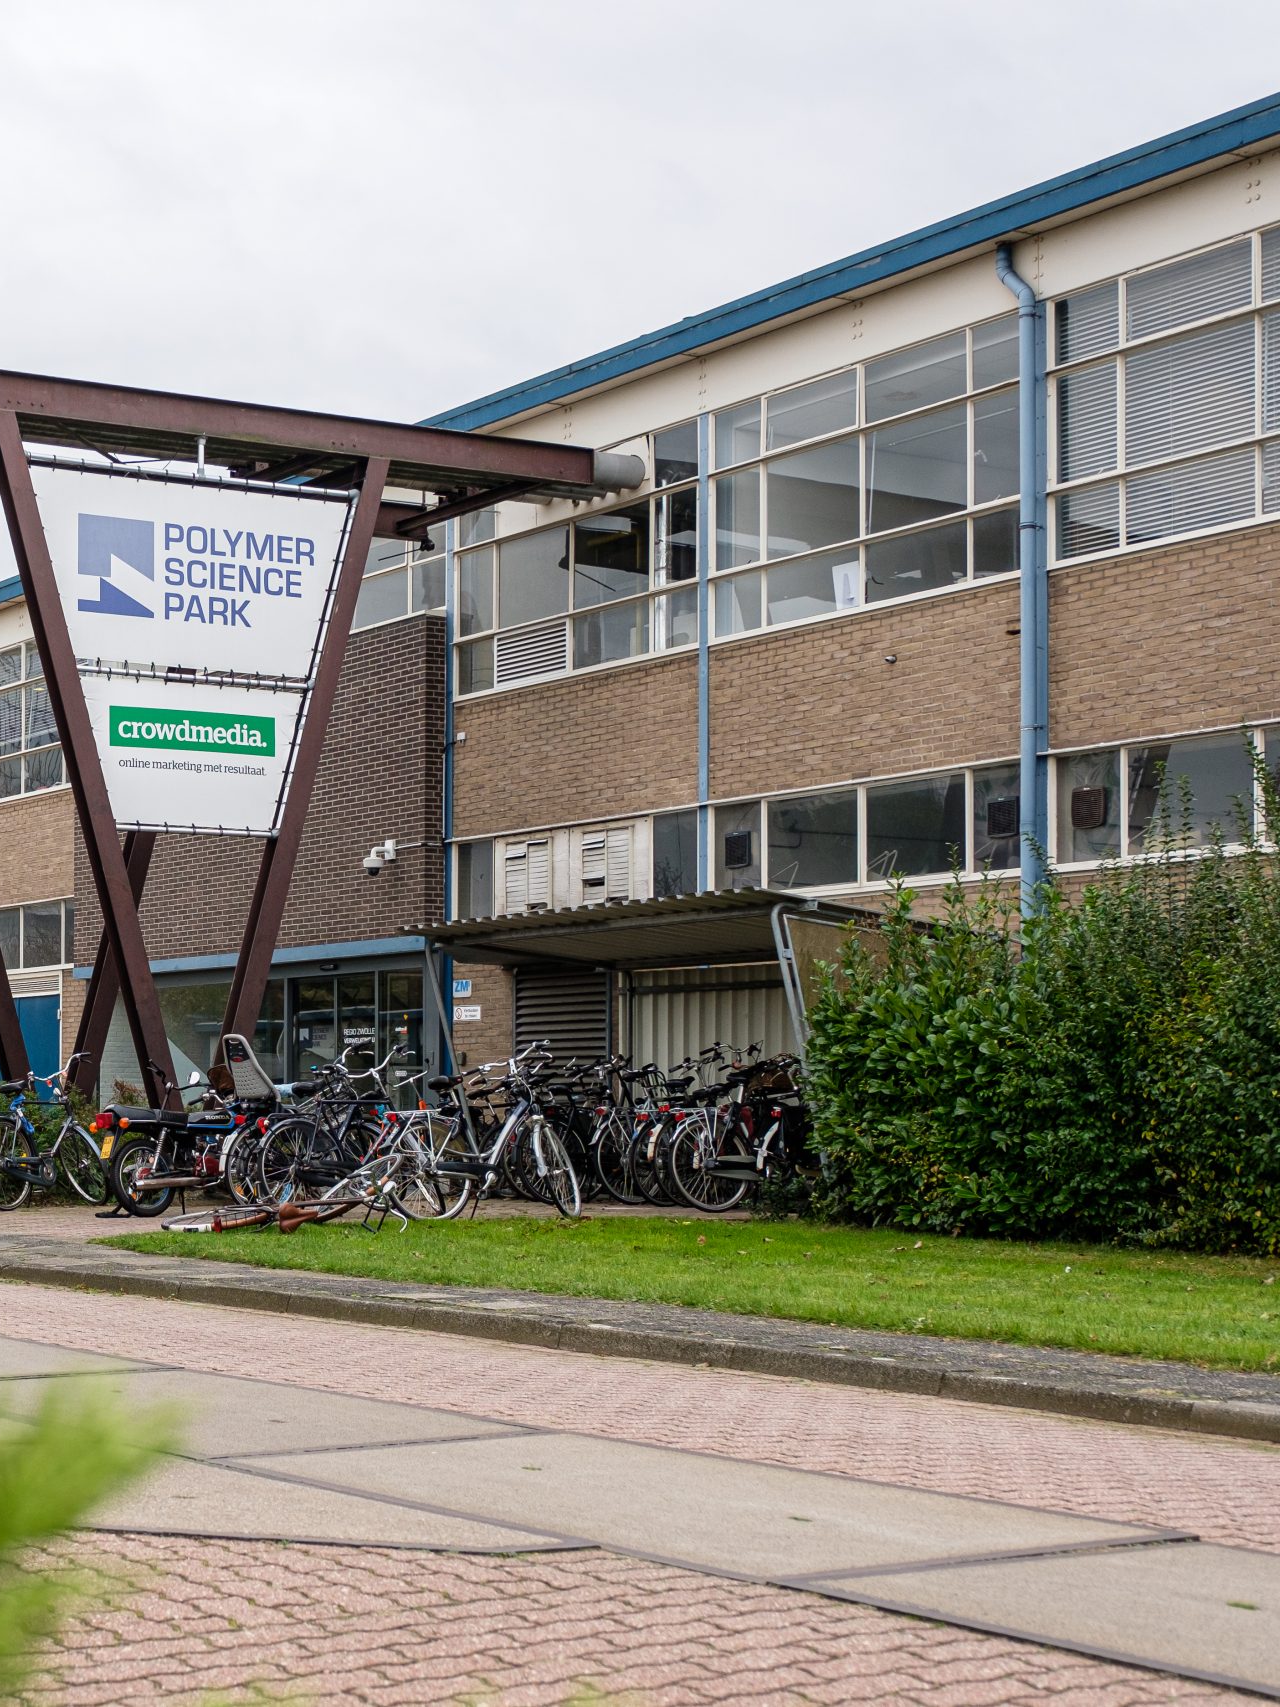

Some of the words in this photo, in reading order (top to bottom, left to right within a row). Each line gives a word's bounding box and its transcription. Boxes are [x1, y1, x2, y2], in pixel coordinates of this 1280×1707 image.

[164, 522, 315, 566] POLYMER
[164, 557, 302, 598] SCIENCE
[164, 592, 252, 628] PARK
[118, 719, 268, 748] crowdmedia.
[118, 758, 151, 769] online
[152, 760, 202, 774] marketing
[203, 763, 223, 773] met
